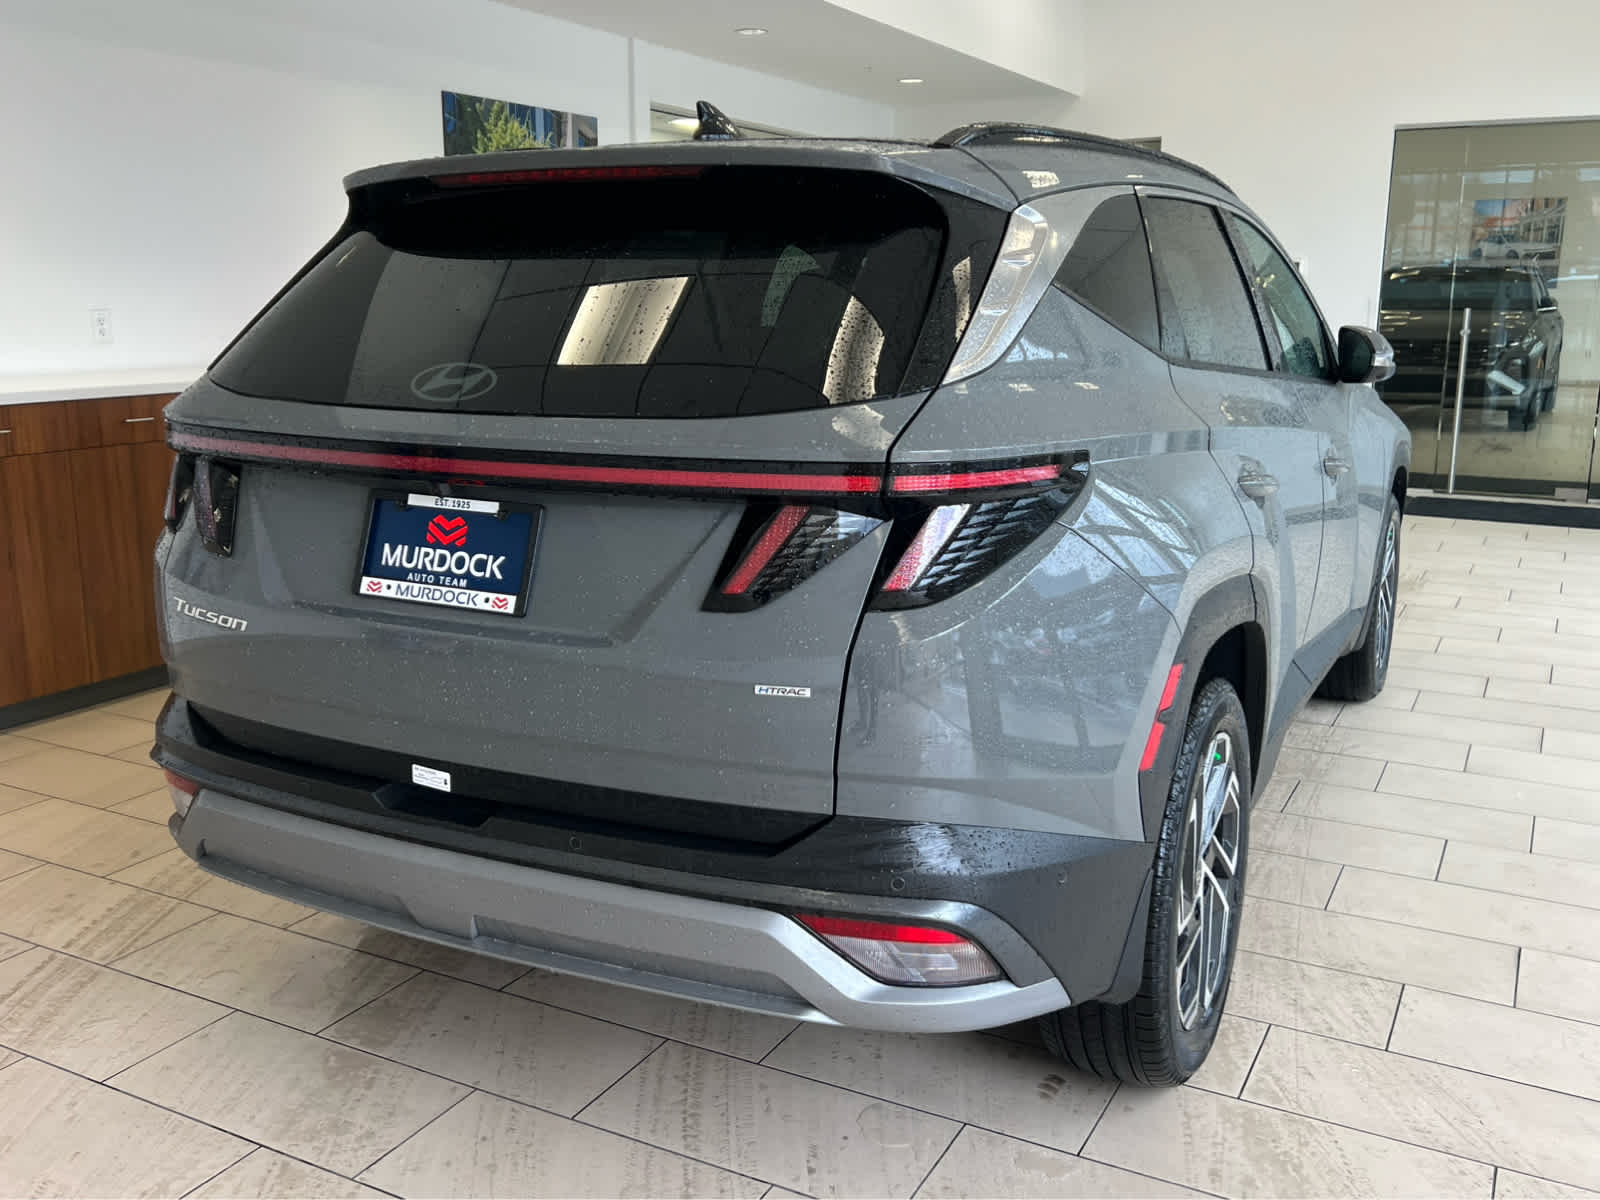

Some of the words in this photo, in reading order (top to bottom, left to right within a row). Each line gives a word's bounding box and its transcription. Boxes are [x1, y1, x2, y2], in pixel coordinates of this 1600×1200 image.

[434, 498, 450, 507] EST.
[452, 499, 471, 509] 1925
[381, 543, 506, 580] MURDOCK
[406, 572, 435, 584] AUTO
[439, 575, 468, 587] TEAM
[395, 583, 480, 607] MURDOCK
[758, 686, 807, 696] HTRAC
